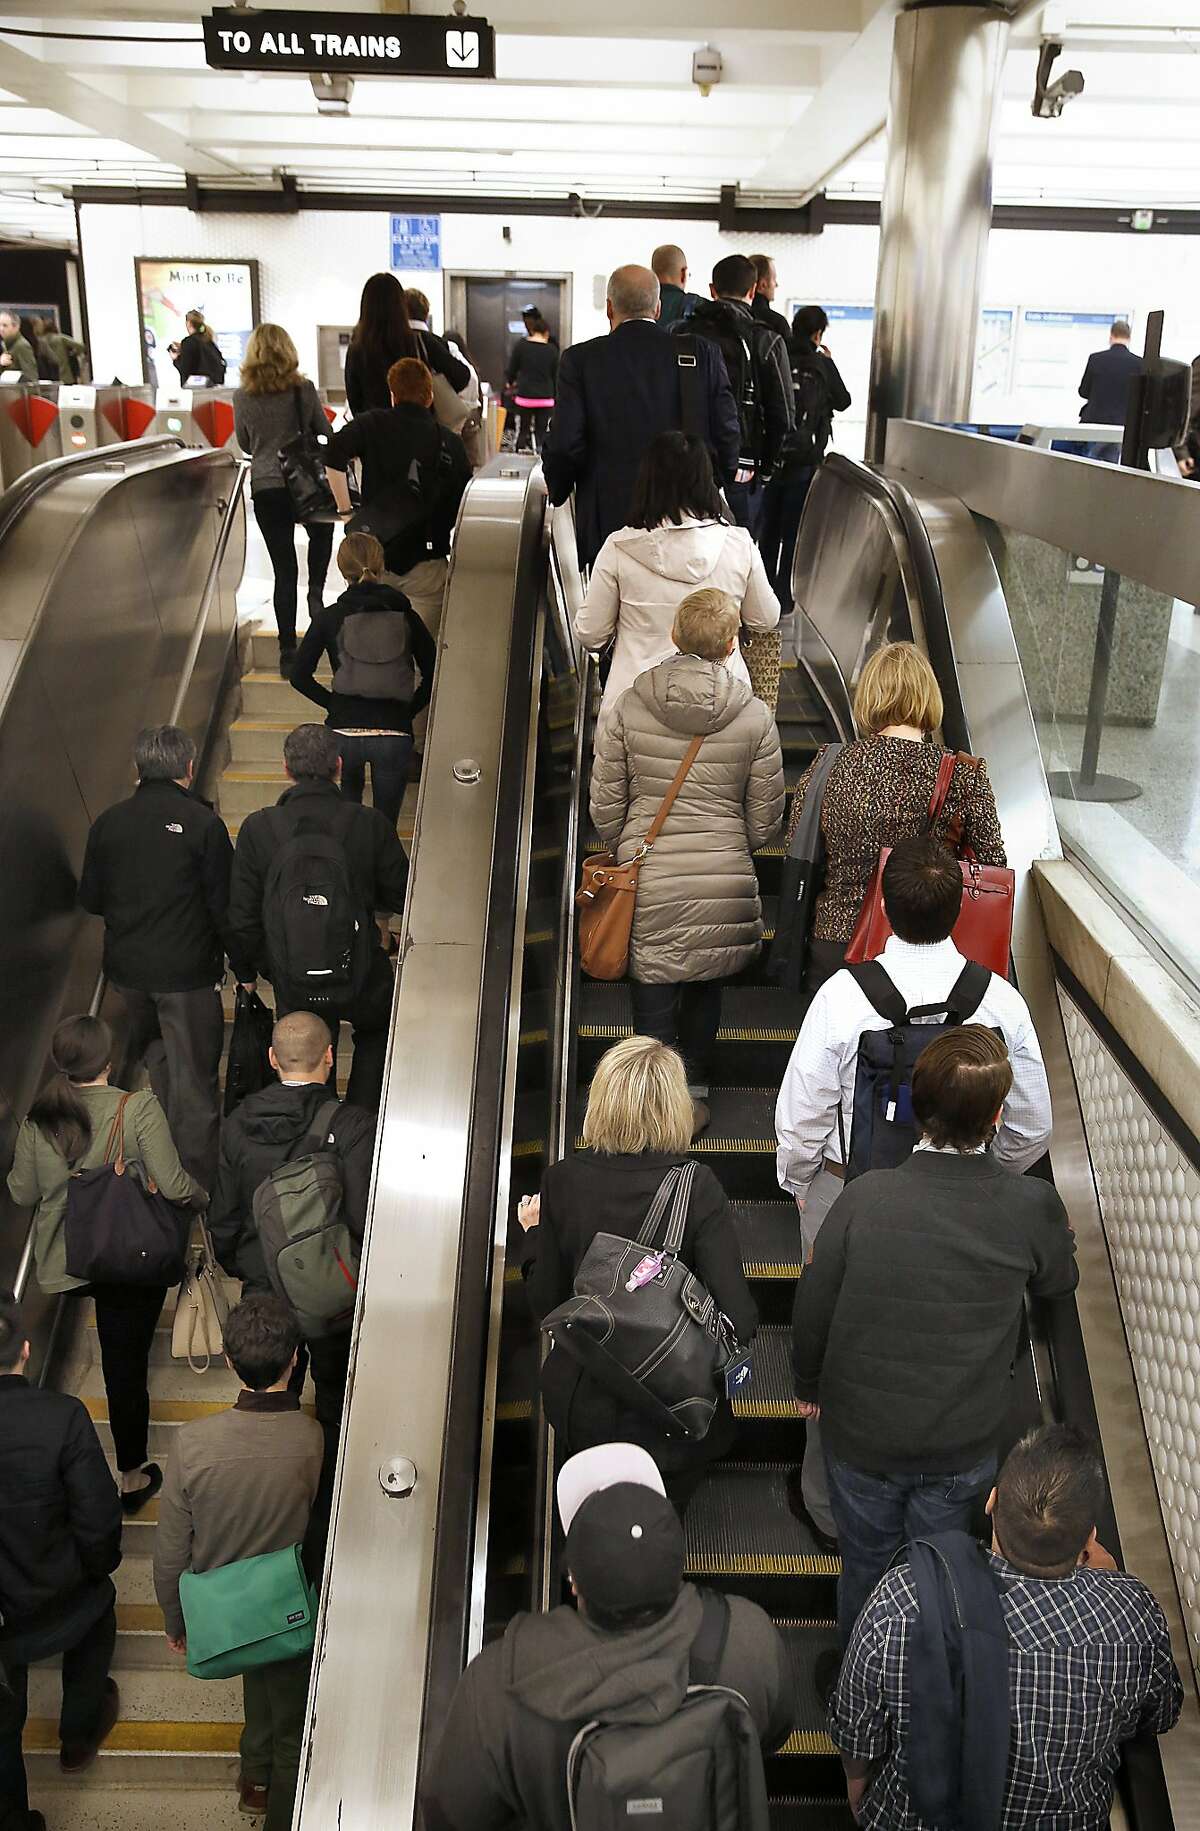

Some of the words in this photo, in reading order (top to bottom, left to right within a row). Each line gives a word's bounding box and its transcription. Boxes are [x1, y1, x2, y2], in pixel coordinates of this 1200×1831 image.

[217, 30, 251, 54] TO
[259, 31, 305, 56] ALL
[310, 33, 401, 59] TRAINS
[169, 270, 199, 283] Mint
[205, 271, 221, 283] To
